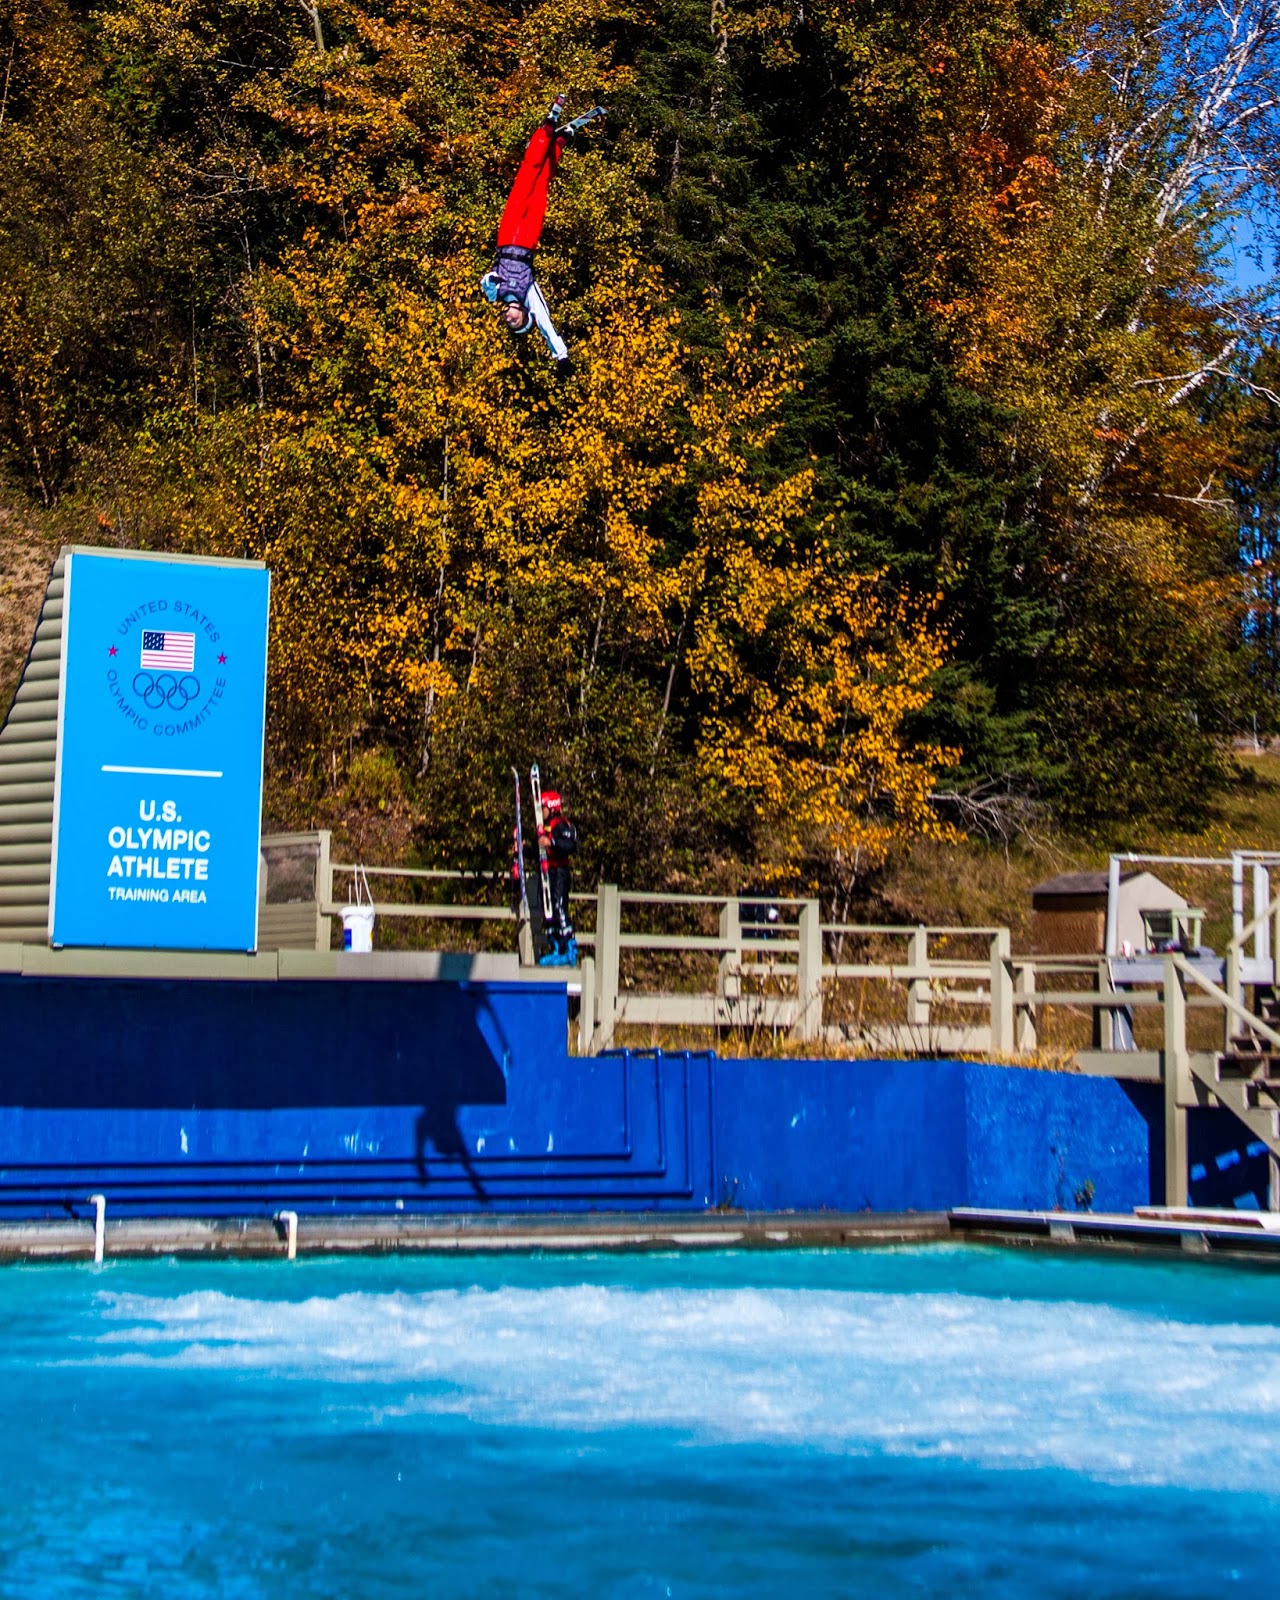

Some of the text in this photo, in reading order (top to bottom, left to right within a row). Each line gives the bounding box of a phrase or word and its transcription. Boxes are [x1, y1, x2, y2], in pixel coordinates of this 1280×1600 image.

[117, 600, 220, 643] UNITED STATES
[107, 669, 226, 737] OLYMPIC COMMITTEE
[139, 799, 182, 823] U.S.
[108, 826, 211, 852] OLYMPIC
[107, 855, 209, 880] ATHLETE
[108, 887, 207, 903] TRAINING AREA
